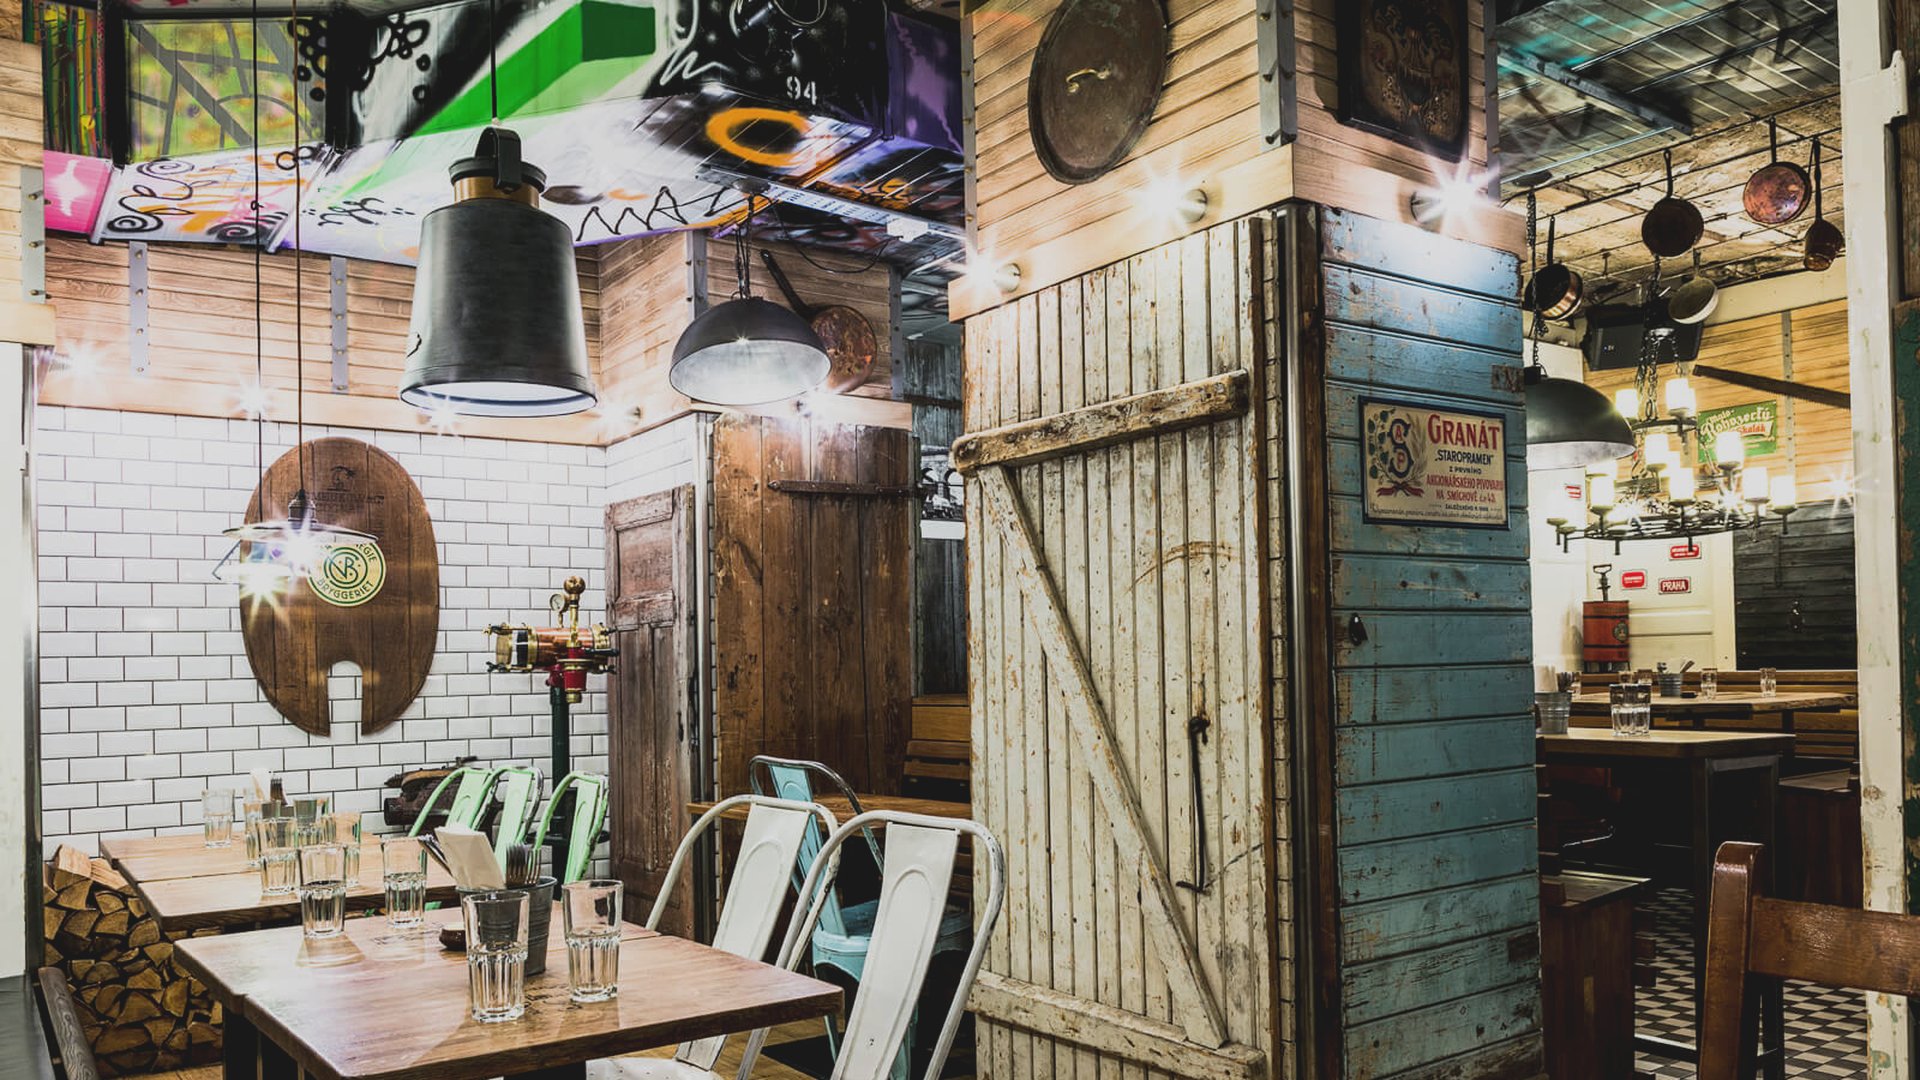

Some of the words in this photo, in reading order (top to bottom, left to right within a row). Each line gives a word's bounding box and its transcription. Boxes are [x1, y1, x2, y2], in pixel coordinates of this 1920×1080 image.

[786, 76, 818, 106] 94
[1427, 413, 1500, 451] GRANÁT
[1436, 490, 1445, 500] NA
[1662, 581, 1686, 591] PRAHA
